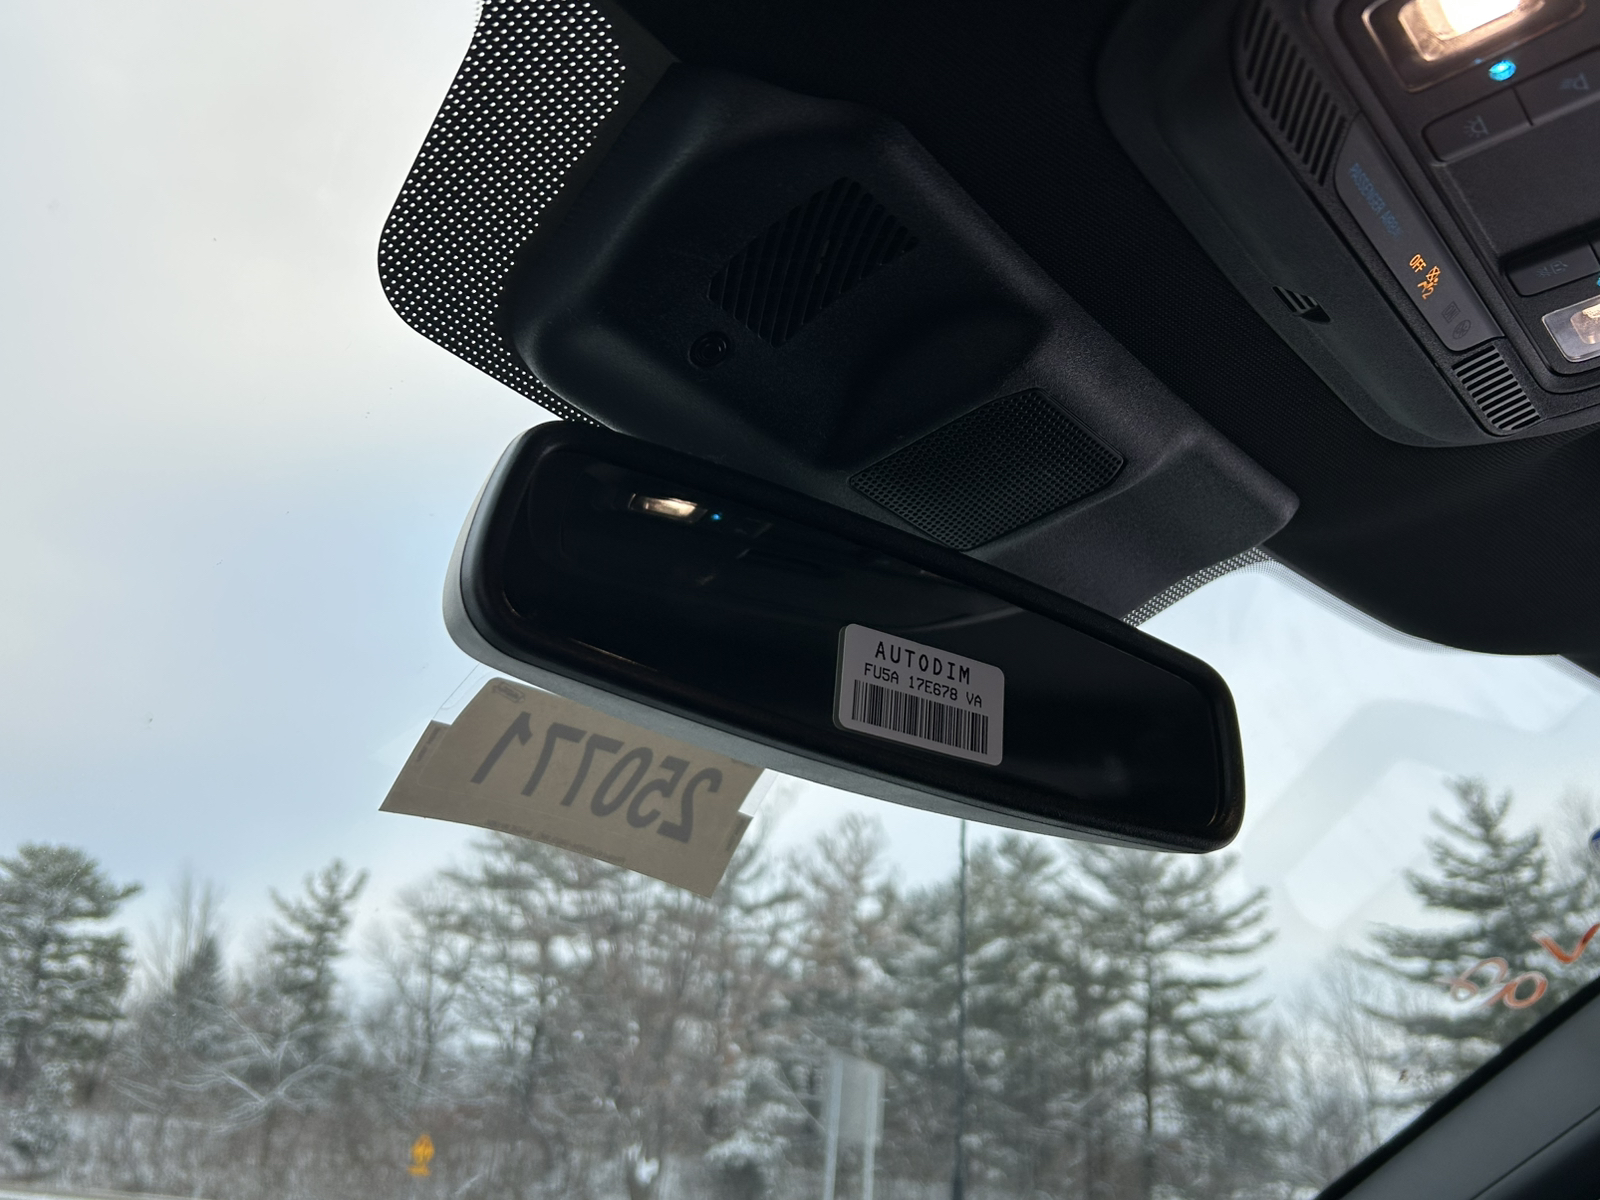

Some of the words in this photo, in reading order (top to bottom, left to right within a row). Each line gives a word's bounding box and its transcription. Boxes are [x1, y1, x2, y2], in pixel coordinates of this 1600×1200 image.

[1409, 254, 1426, 272] OFF
[864, 662, 899, 684] FU5A
[908, 675, 958, 701] 17E678
[966, 691, 982, 708] VA
[875, 641, 970, 685] AUTODIM
